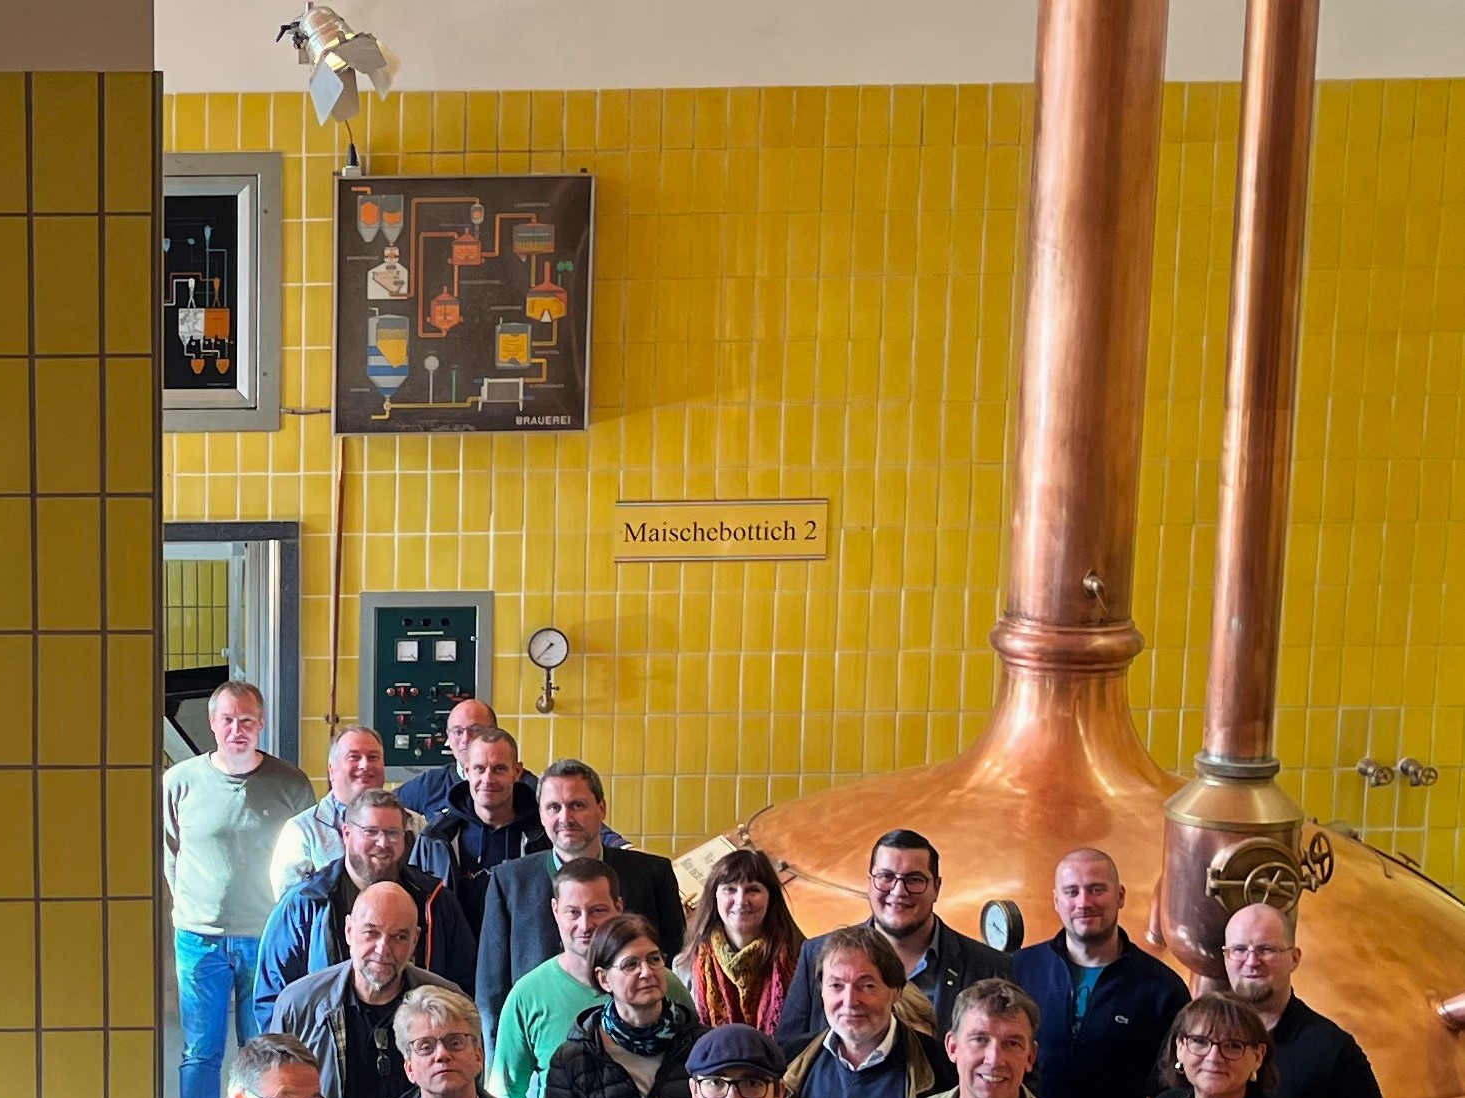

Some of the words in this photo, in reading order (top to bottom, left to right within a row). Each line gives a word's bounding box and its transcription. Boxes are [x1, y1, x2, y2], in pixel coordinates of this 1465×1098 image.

[516, 415, 571, 426] BRAUEREI
[624, 520, 796, 543] Maischebottich
[803, 520, 817, 540] 2
